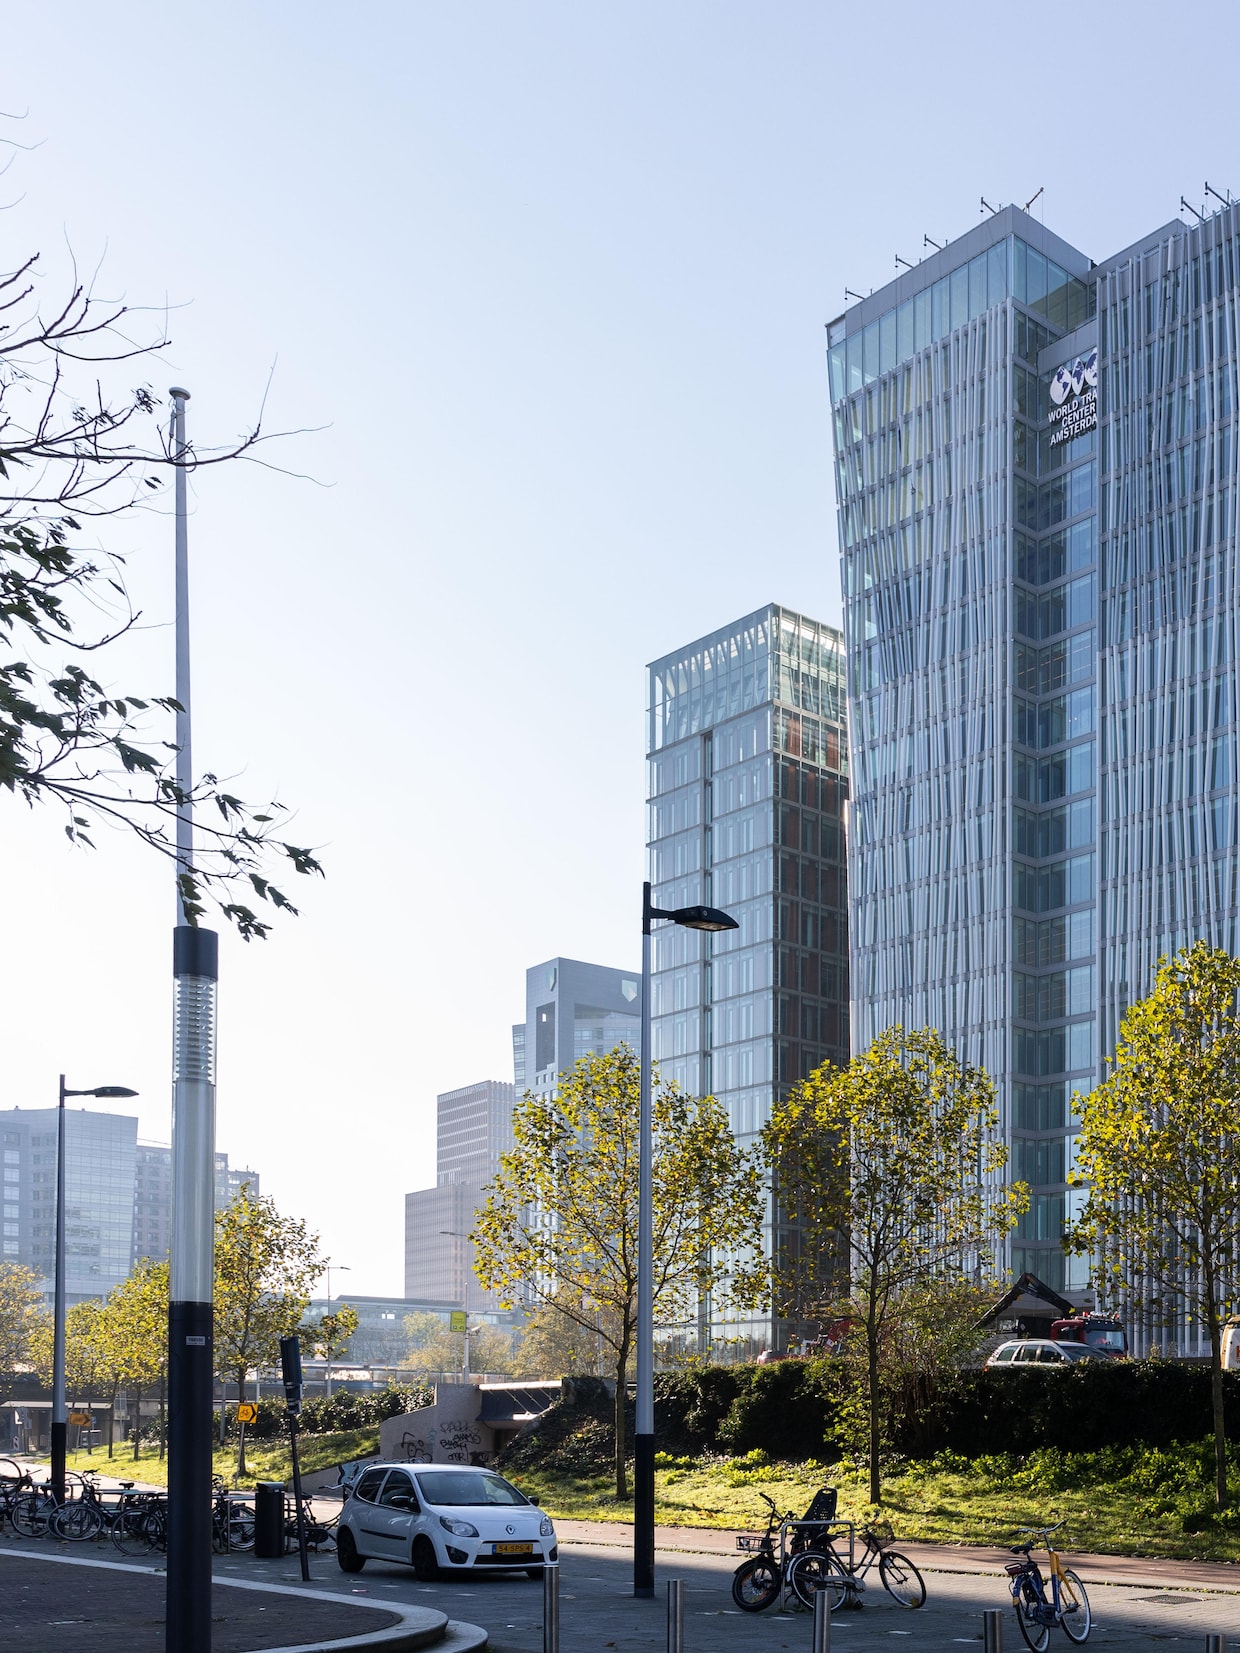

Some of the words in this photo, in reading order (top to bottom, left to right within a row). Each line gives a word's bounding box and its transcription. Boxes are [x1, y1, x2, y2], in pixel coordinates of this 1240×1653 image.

[1048, 400, 1079, 423] WORLD
[1081, 390, 1097, 405] TRA
[1061, 402, 1096, 427] CENTER
[1050, 413, 1097, 446] AMSTERDA
